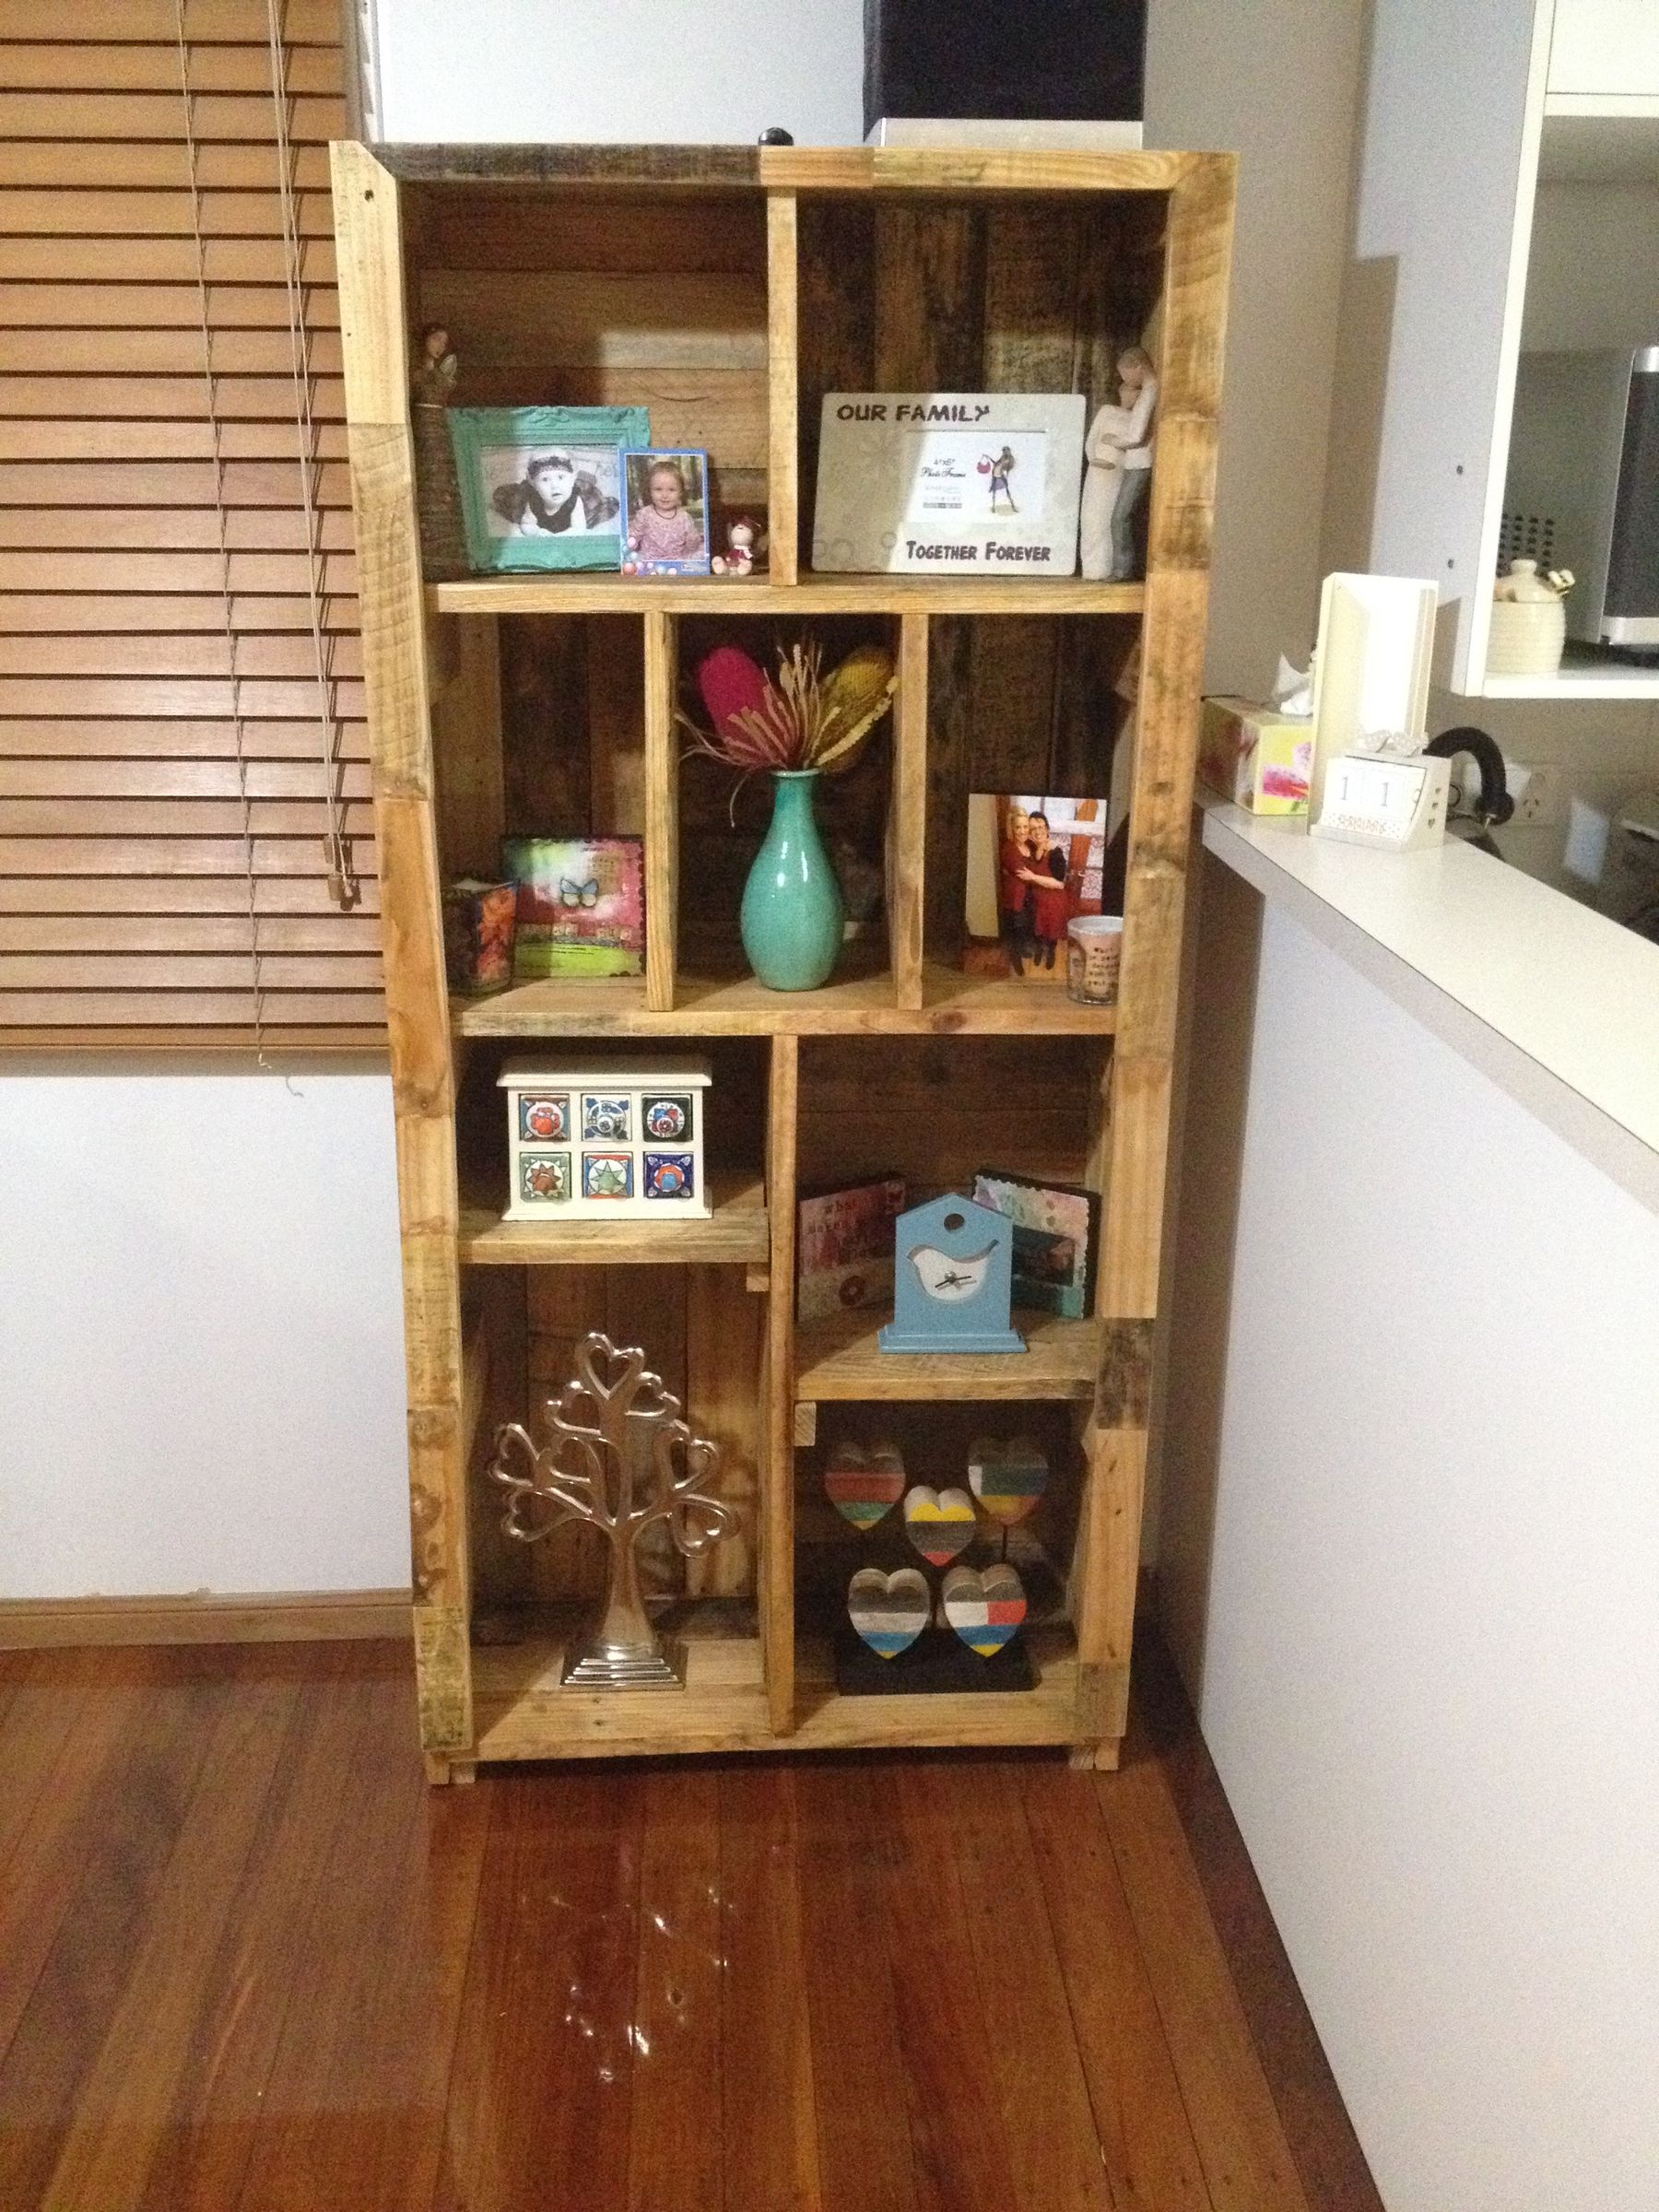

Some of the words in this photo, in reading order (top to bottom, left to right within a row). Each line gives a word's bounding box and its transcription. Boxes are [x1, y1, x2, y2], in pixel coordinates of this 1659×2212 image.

[837, 404, 887, 421] OUR
[896, 404, 990, 422] FAMILY
[1339, 776, 1349, 801] 1
[1381, 782, 1390, 807] 1
